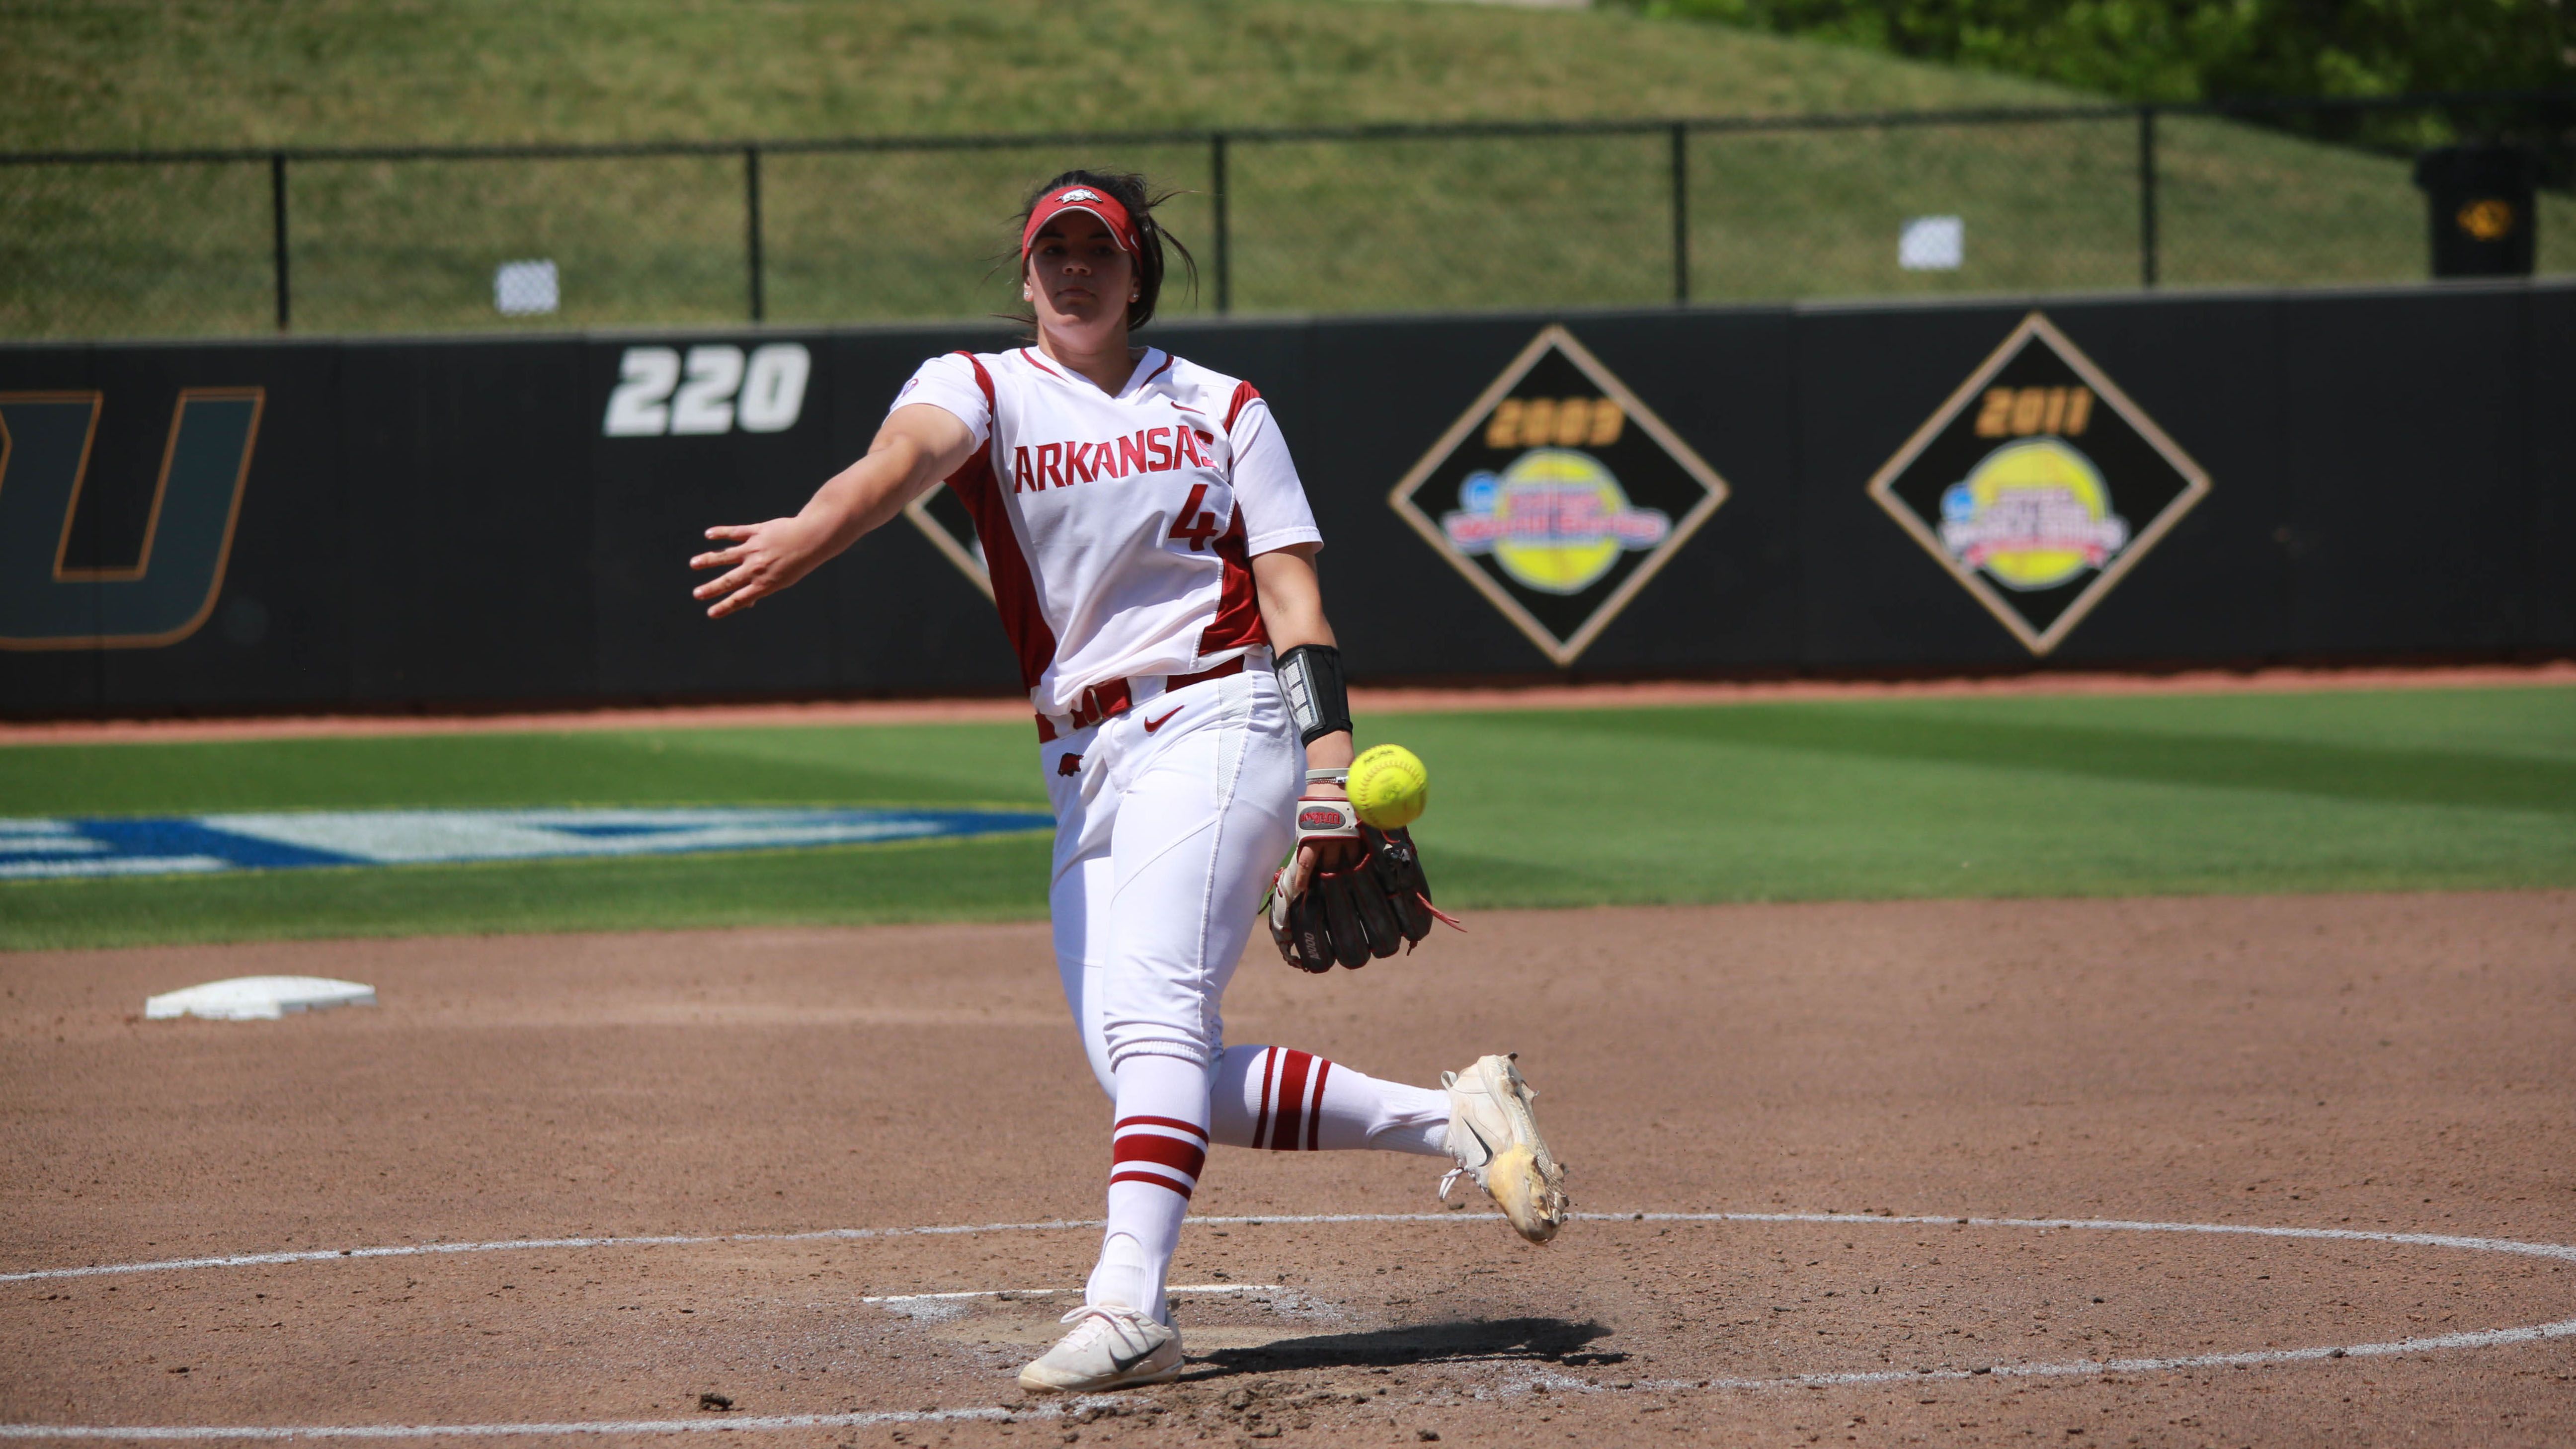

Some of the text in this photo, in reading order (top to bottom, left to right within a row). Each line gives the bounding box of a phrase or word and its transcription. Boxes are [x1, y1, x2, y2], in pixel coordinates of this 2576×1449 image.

[602, 344, 811, 437] 220
[1975, 386, 2095, 437] 2011
[1014, 425, 1217, 493] ARKANSAS
[1168, 483, 1218, 552] 4
